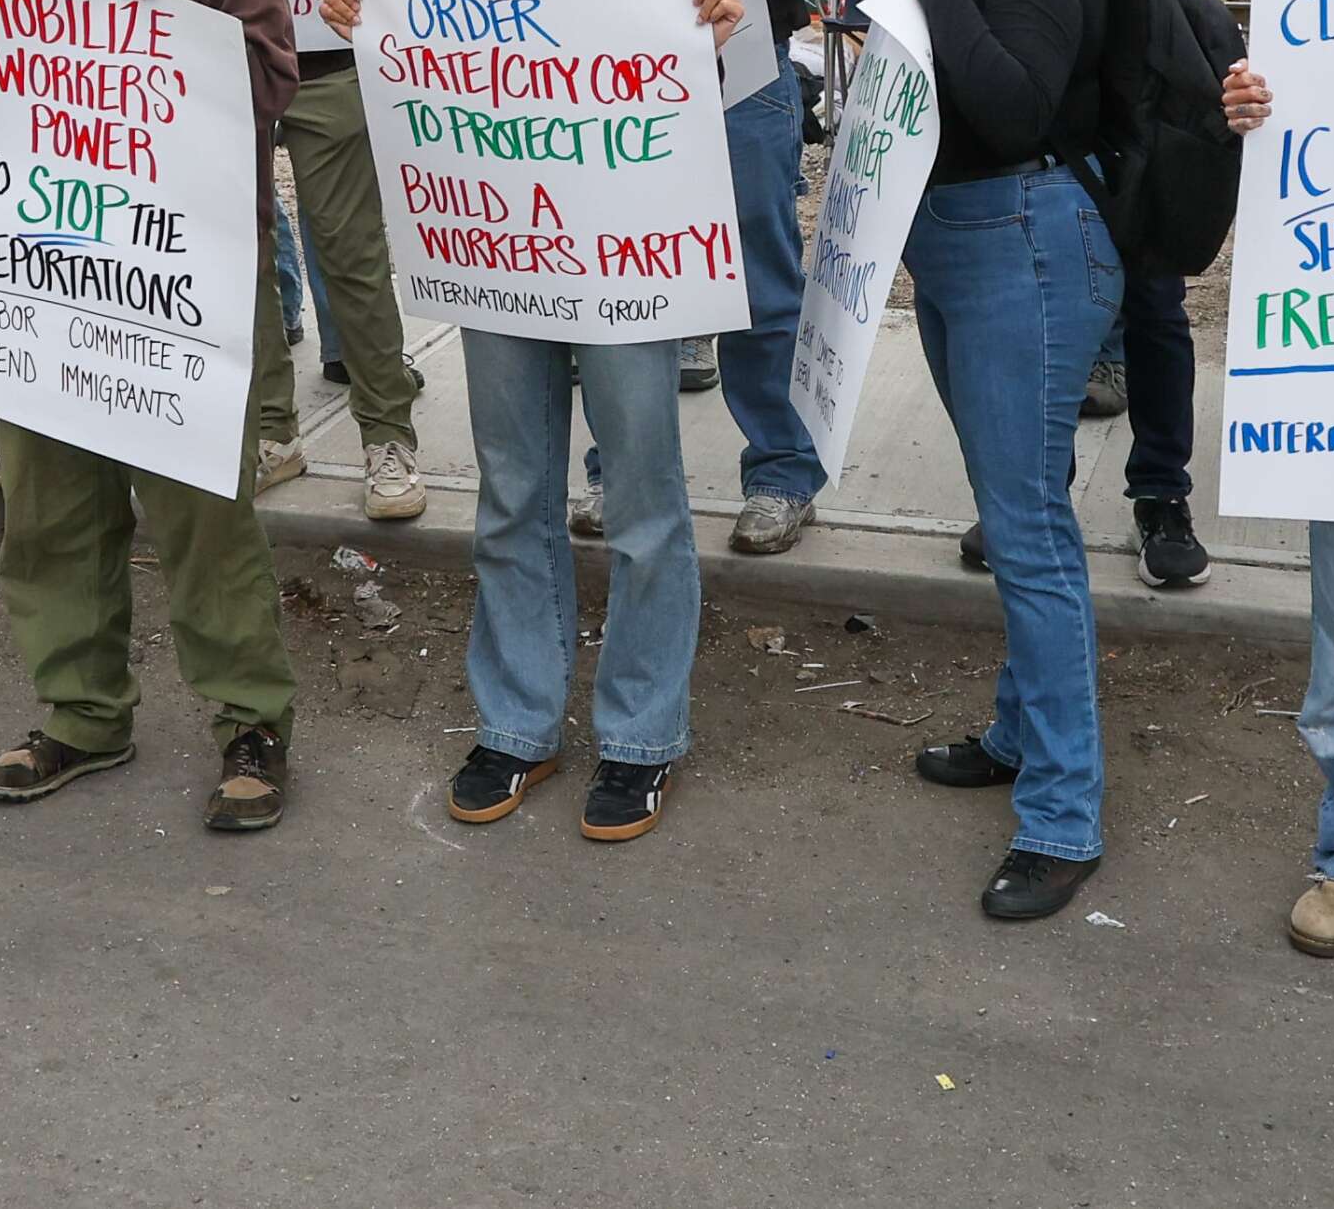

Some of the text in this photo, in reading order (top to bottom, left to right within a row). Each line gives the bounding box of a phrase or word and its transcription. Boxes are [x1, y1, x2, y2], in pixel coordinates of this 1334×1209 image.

[379, 33, 690, 108] STATE/CITY COPS
[884, 62, 930, 136] CARE
[31, 104, 157, 184] POWER
[393, 100, 681, 170] TO PROTECT ICE
[845, 117, 893, 200] WORKER
[17, 165, 130, 243] STOP
[129, 202, 188, 254] THE
[400, 164, 563, 230] BUILD A
[416, 221, 736, 281] WORKERS PARTY!
[410, 274, 669, 325] INTERNATIONALIST GROUP
[68, 316, 173, 371] COMMITTEE
[182, 352, 206, 382] TO
[60, 361, 186, 427] IMMIGRANTS
